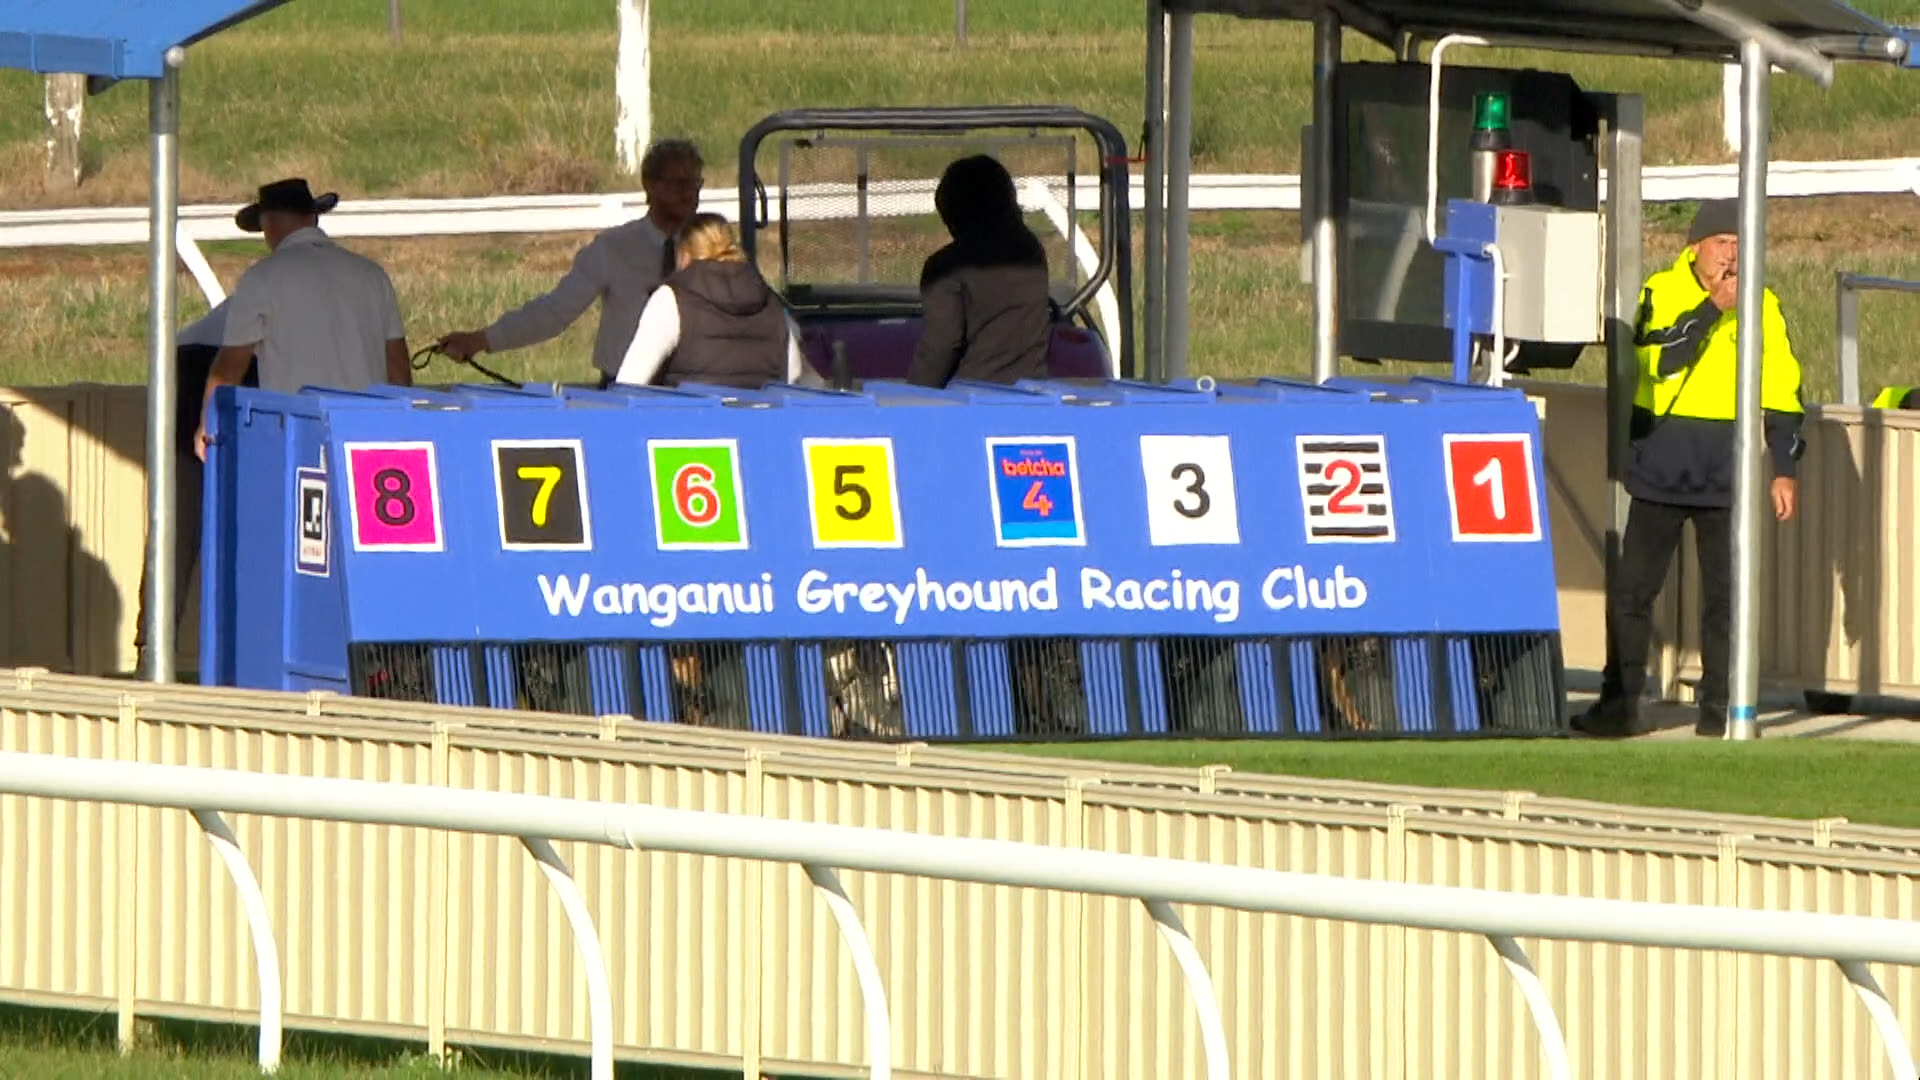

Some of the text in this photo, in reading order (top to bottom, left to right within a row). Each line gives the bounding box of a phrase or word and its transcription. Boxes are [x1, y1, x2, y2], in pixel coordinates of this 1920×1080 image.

[673, 463, 721, 527] 6
[834, 465, 872, 521] 5
[1001, 458, 1066, 477] betcha
[1171, 463, 1211, 519] 3
[1320, 460, 1364, 514] 2
[1473, 458, 1506, 520] 1
[375, 468, 415, 525] 8
[518, 467, 562, 527] 7
[1022, 480, 1054, 517] 4
[538, 565, 1368, 627] Wanganui Greyhound Racing Club
